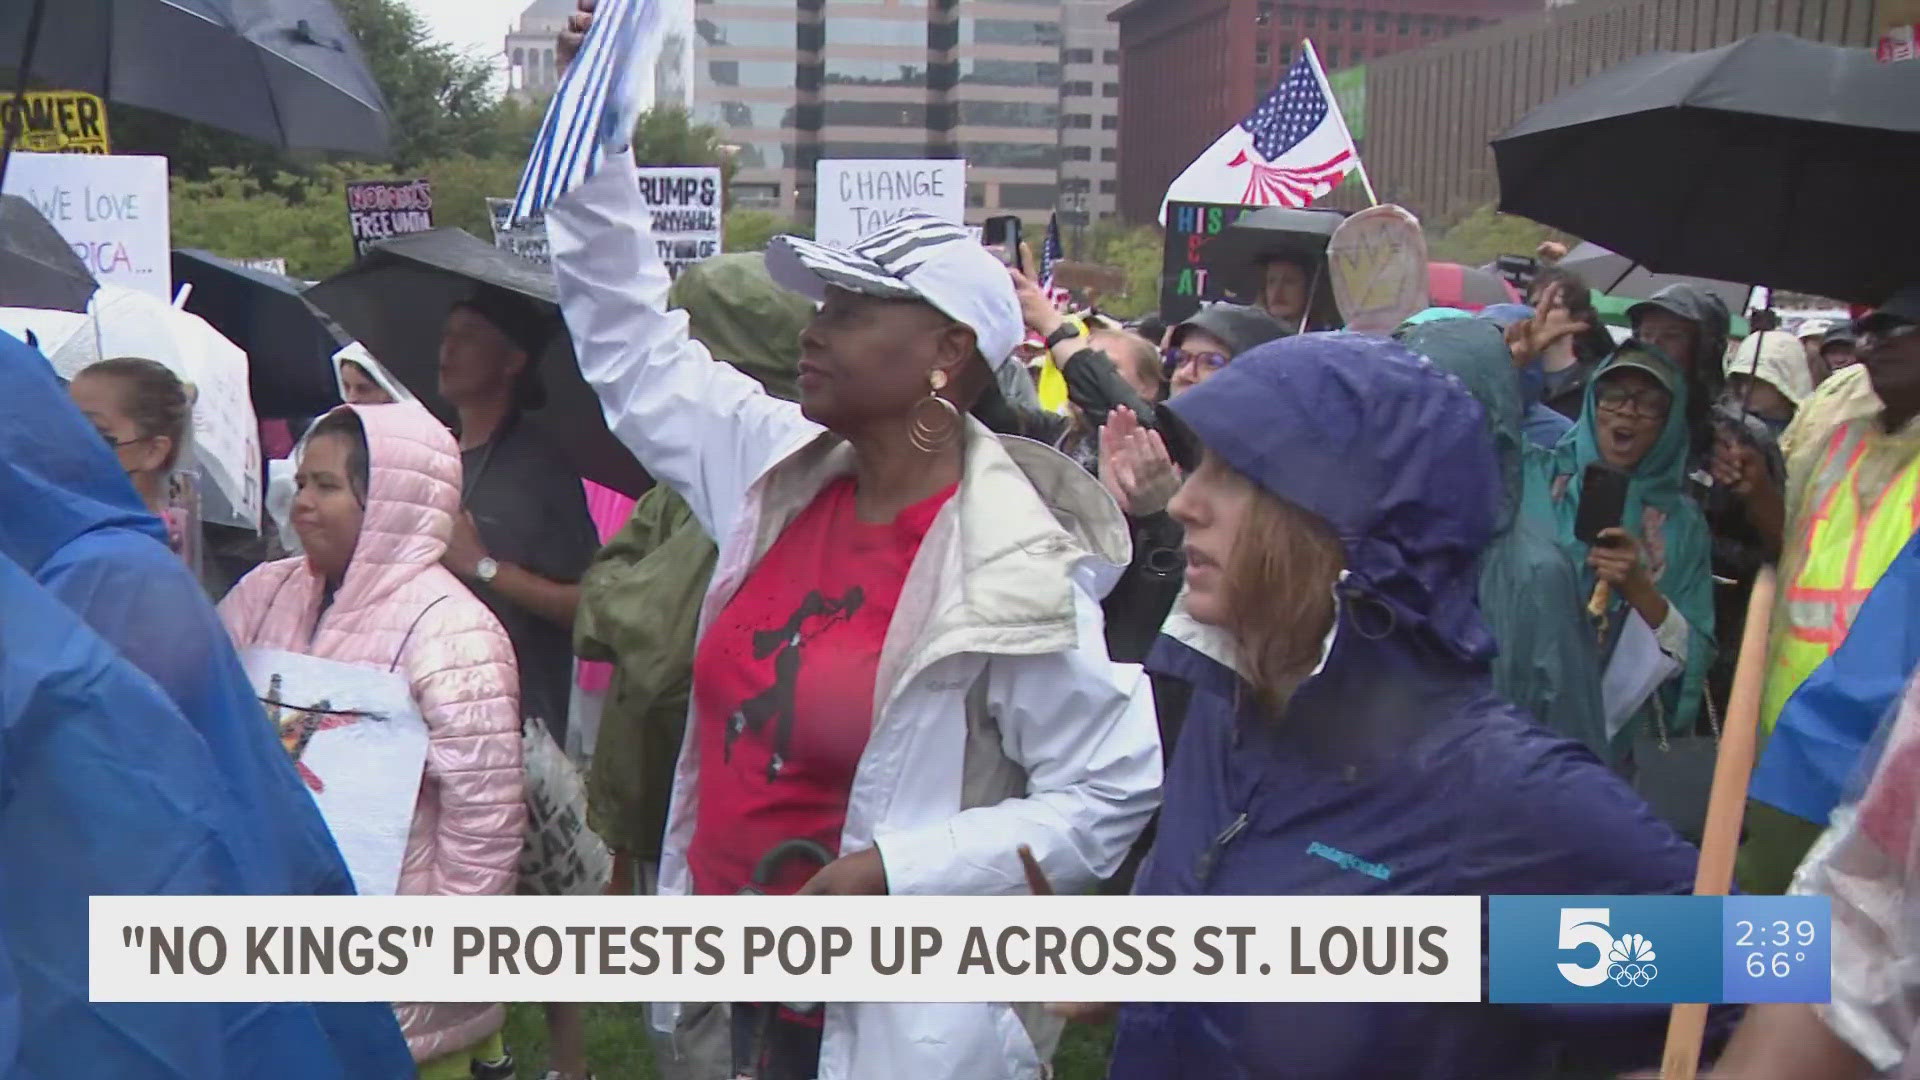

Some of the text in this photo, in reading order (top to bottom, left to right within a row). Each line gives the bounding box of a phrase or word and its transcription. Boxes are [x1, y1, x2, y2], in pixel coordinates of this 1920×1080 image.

[840, 169, 944, 201] CHANGE
[29, 185, 139, 222] WE LOVE
[351, 211, 393, 239] FREE
